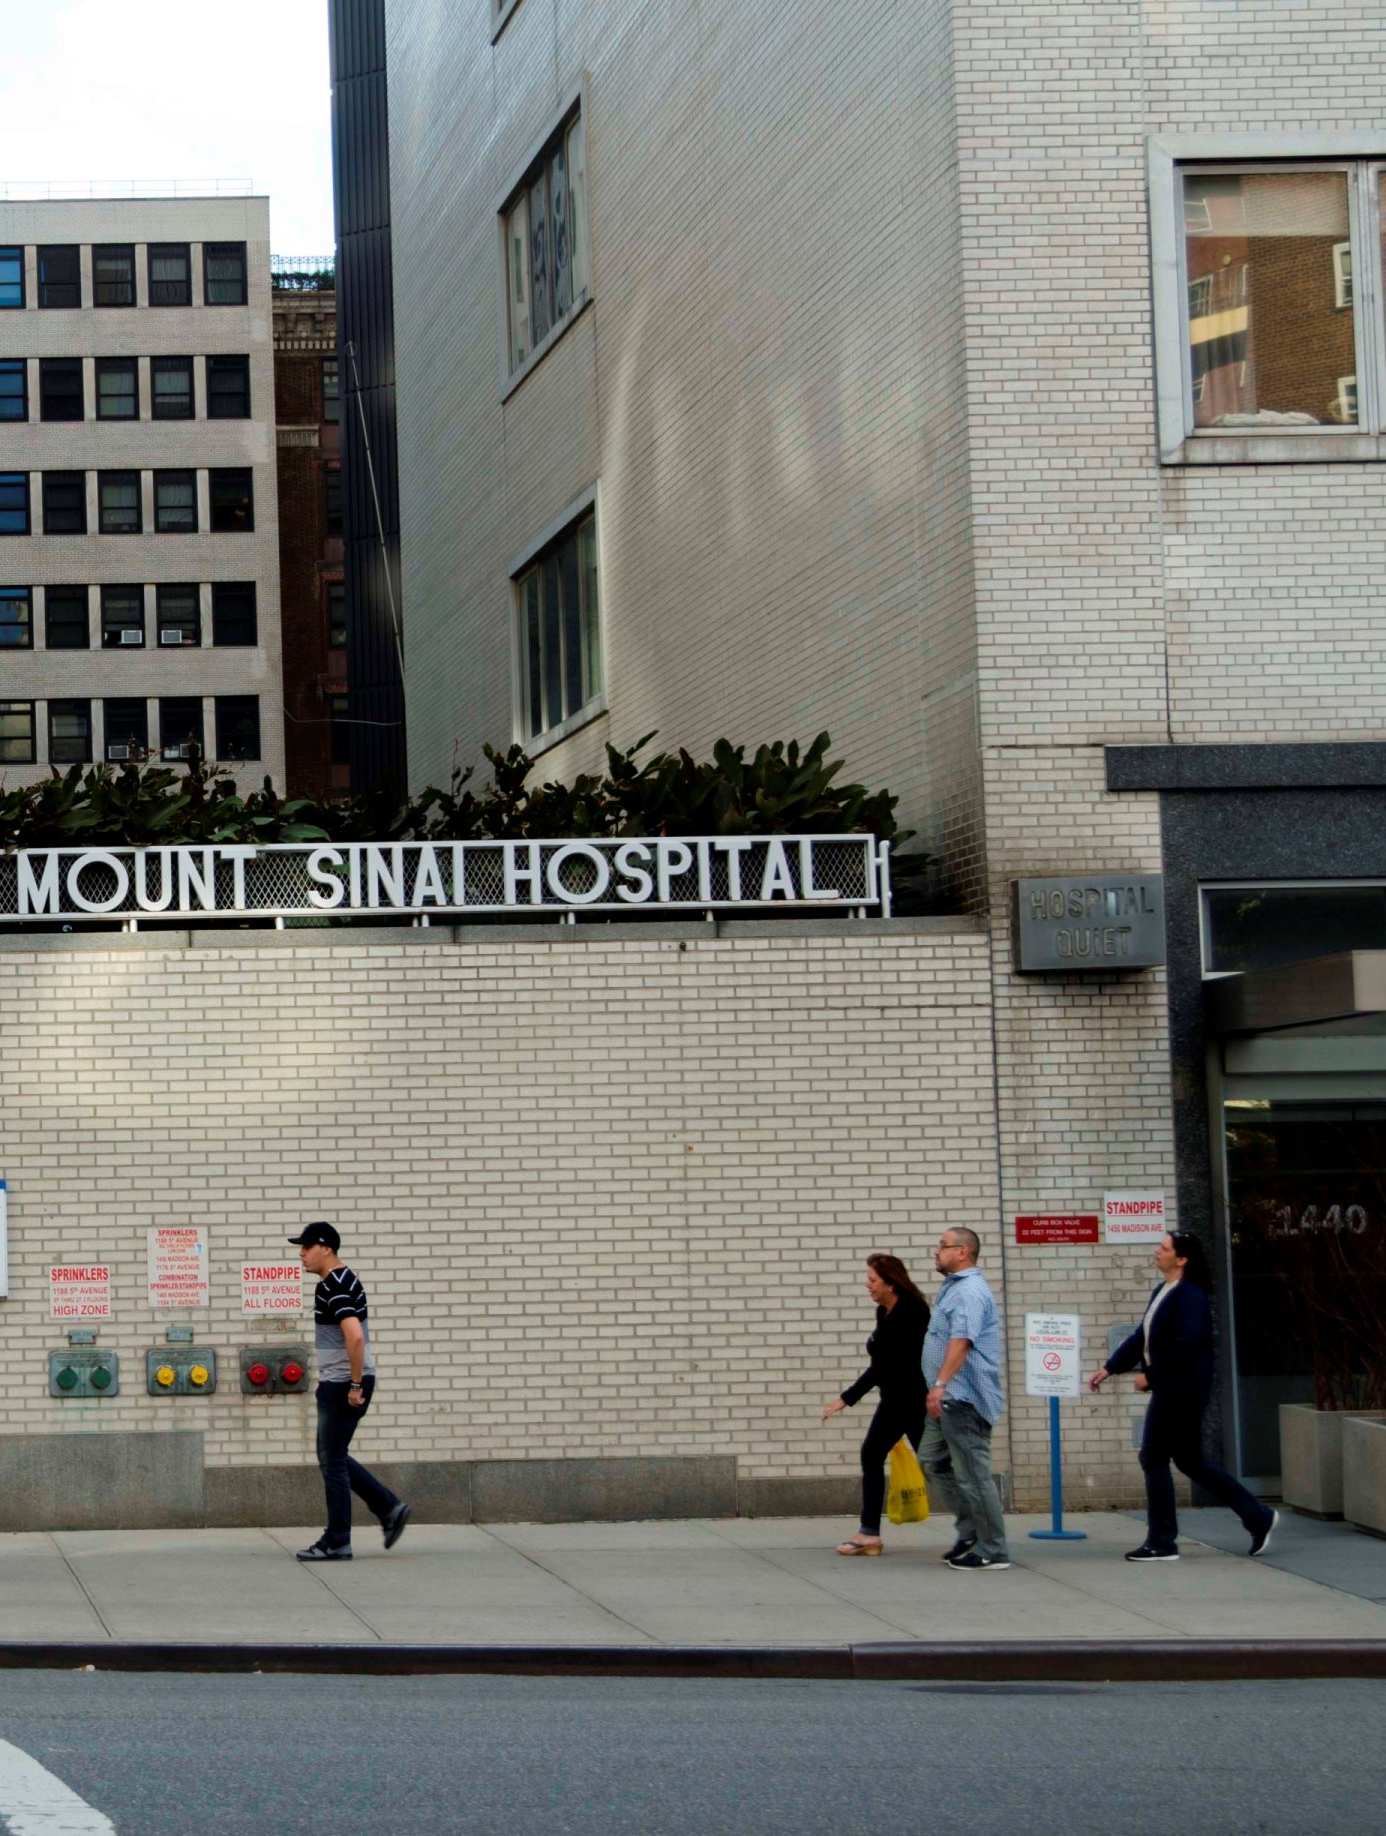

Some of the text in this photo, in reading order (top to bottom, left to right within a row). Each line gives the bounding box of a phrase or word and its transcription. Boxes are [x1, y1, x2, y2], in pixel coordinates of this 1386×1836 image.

[18, 850, 256, 914] MOUNT
[307, 845, 464, 909] SINAI
[503, 841, 839, 905] HOSPITAL
[1031, 886, 1155, 920] HOSPITAL
[1107, 1201, 1163, 1214] STANDPIPE
[1276, 1204, 1366, 1235] 1440
[1122, 1224, 1149, 1232] MADISON
[51, 1268, 108, 1281] SPRINKLERS
[243, 1267, 300, 1280] STANDPIPE
[80, 1286, 108, 1294] AVENUE
[271, 1285, 300, 1294] AVENUE
[244, 1298, 301, 1308] ALL FLOORS
[54, 1305, 108, 1315] HIGH ZONE
